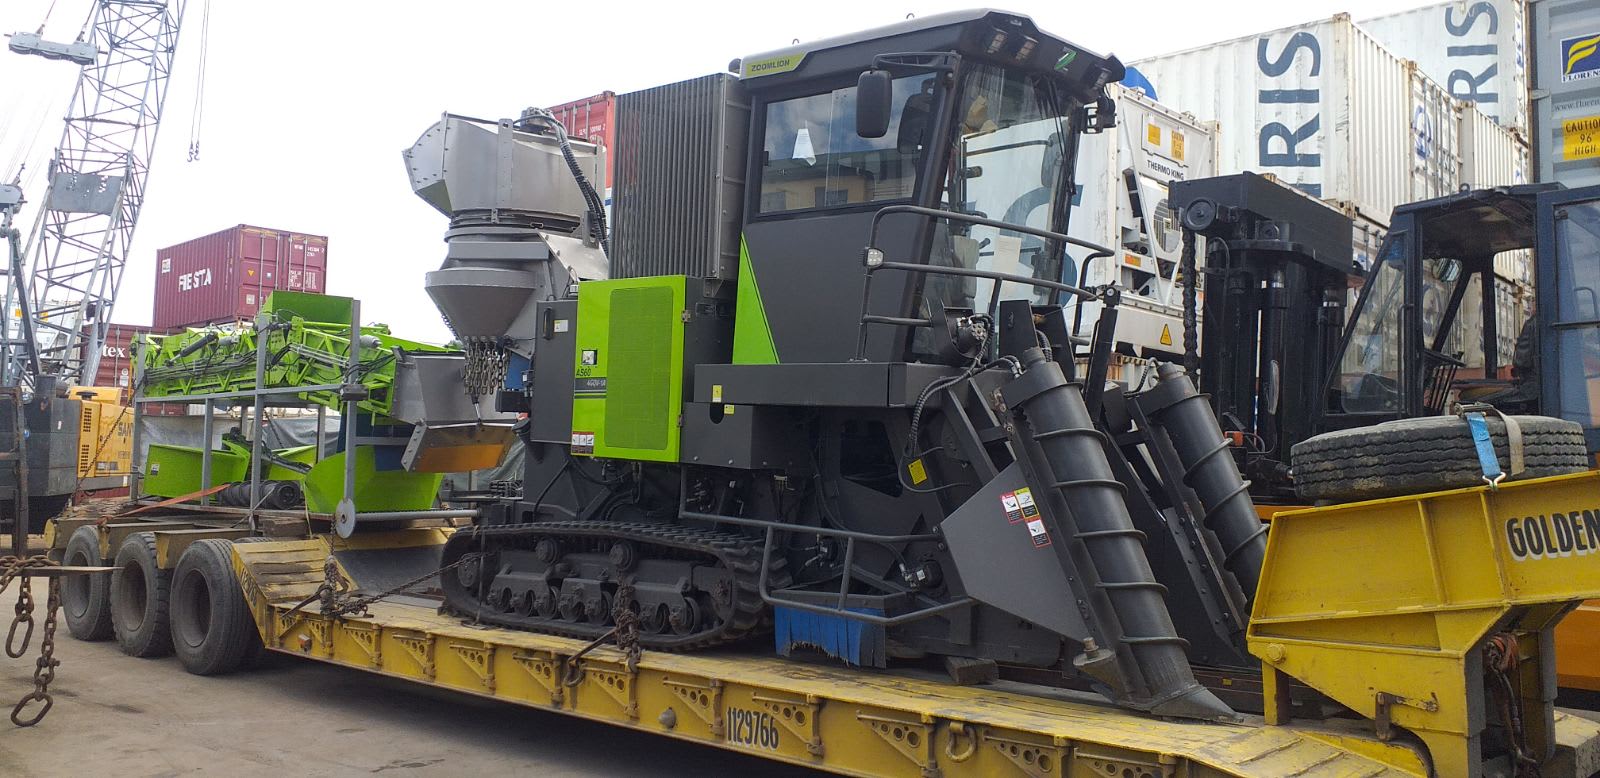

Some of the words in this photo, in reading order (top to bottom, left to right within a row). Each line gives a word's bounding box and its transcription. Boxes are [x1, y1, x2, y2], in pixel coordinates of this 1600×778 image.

[751, 59, 790, 72] ZOOMLION
[1445, 1, 1499, 124] RIS
[1562, 69, 1600, 82] FLOREN
[1257, 32, 1321, 197] RIS
[1565, 118, 1600, 133] CAUTIO
[1574, 144, 1596, 156] HIGH
[1147, 159, 1171, 176] THERMO
[1171, 169, 1184, 181] KING
[178, 268, 212, 292] FIESTA
[102, 344, 126, 358] tex
[576, 368, 591, 377] AS60
[118, 422, 134, 437] SAN
[1505, 508, 1600, 561] GOLDEN
[727, 706, 779, 750] 1129766
